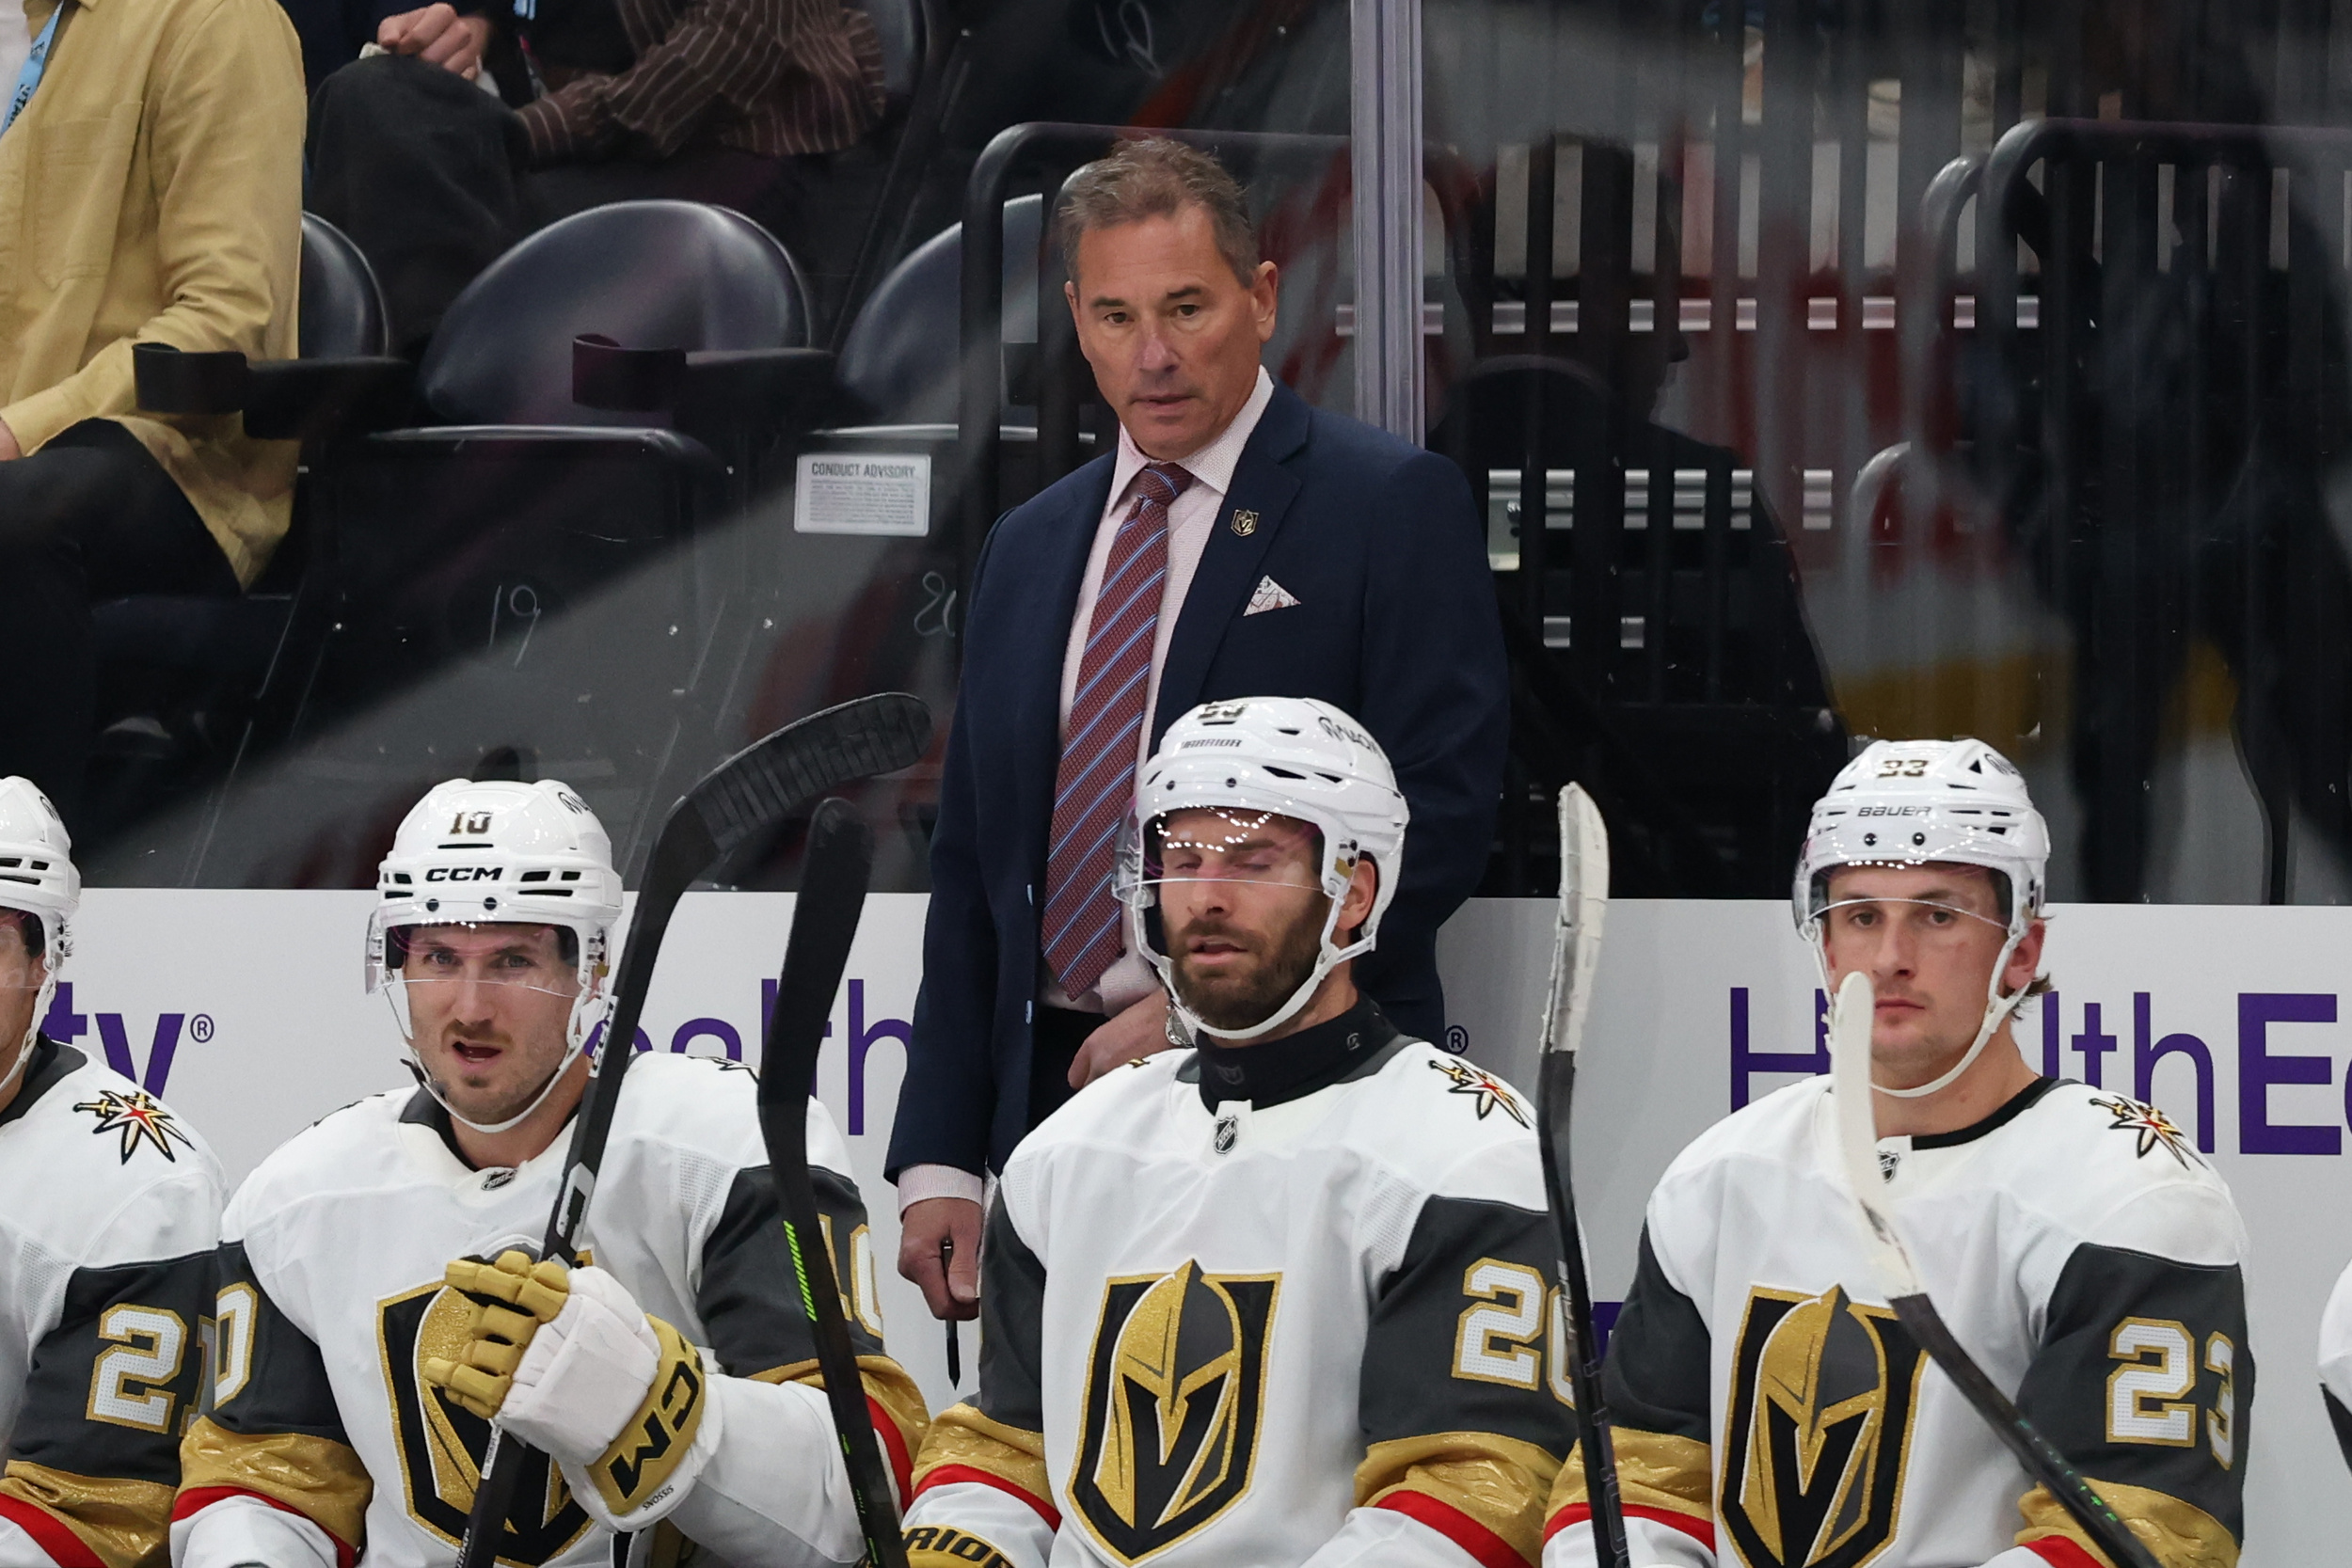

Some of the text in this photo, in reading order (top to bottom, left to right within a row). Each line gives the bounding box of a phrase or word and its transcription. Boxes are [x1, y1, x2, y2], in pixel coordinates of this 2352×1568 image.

[811, 462, 915, 479] CONDUCT ADVISORY
[488, 584, 542, 669] 19
[449, 811, 493, 835] 10
[1857, 805, 1931, 817] BAUER
[425, 867, 503, 882] CCM
[2105, 1316, 2235, 1471] 23
[643, 1484, 675, 1511] SISSONS
